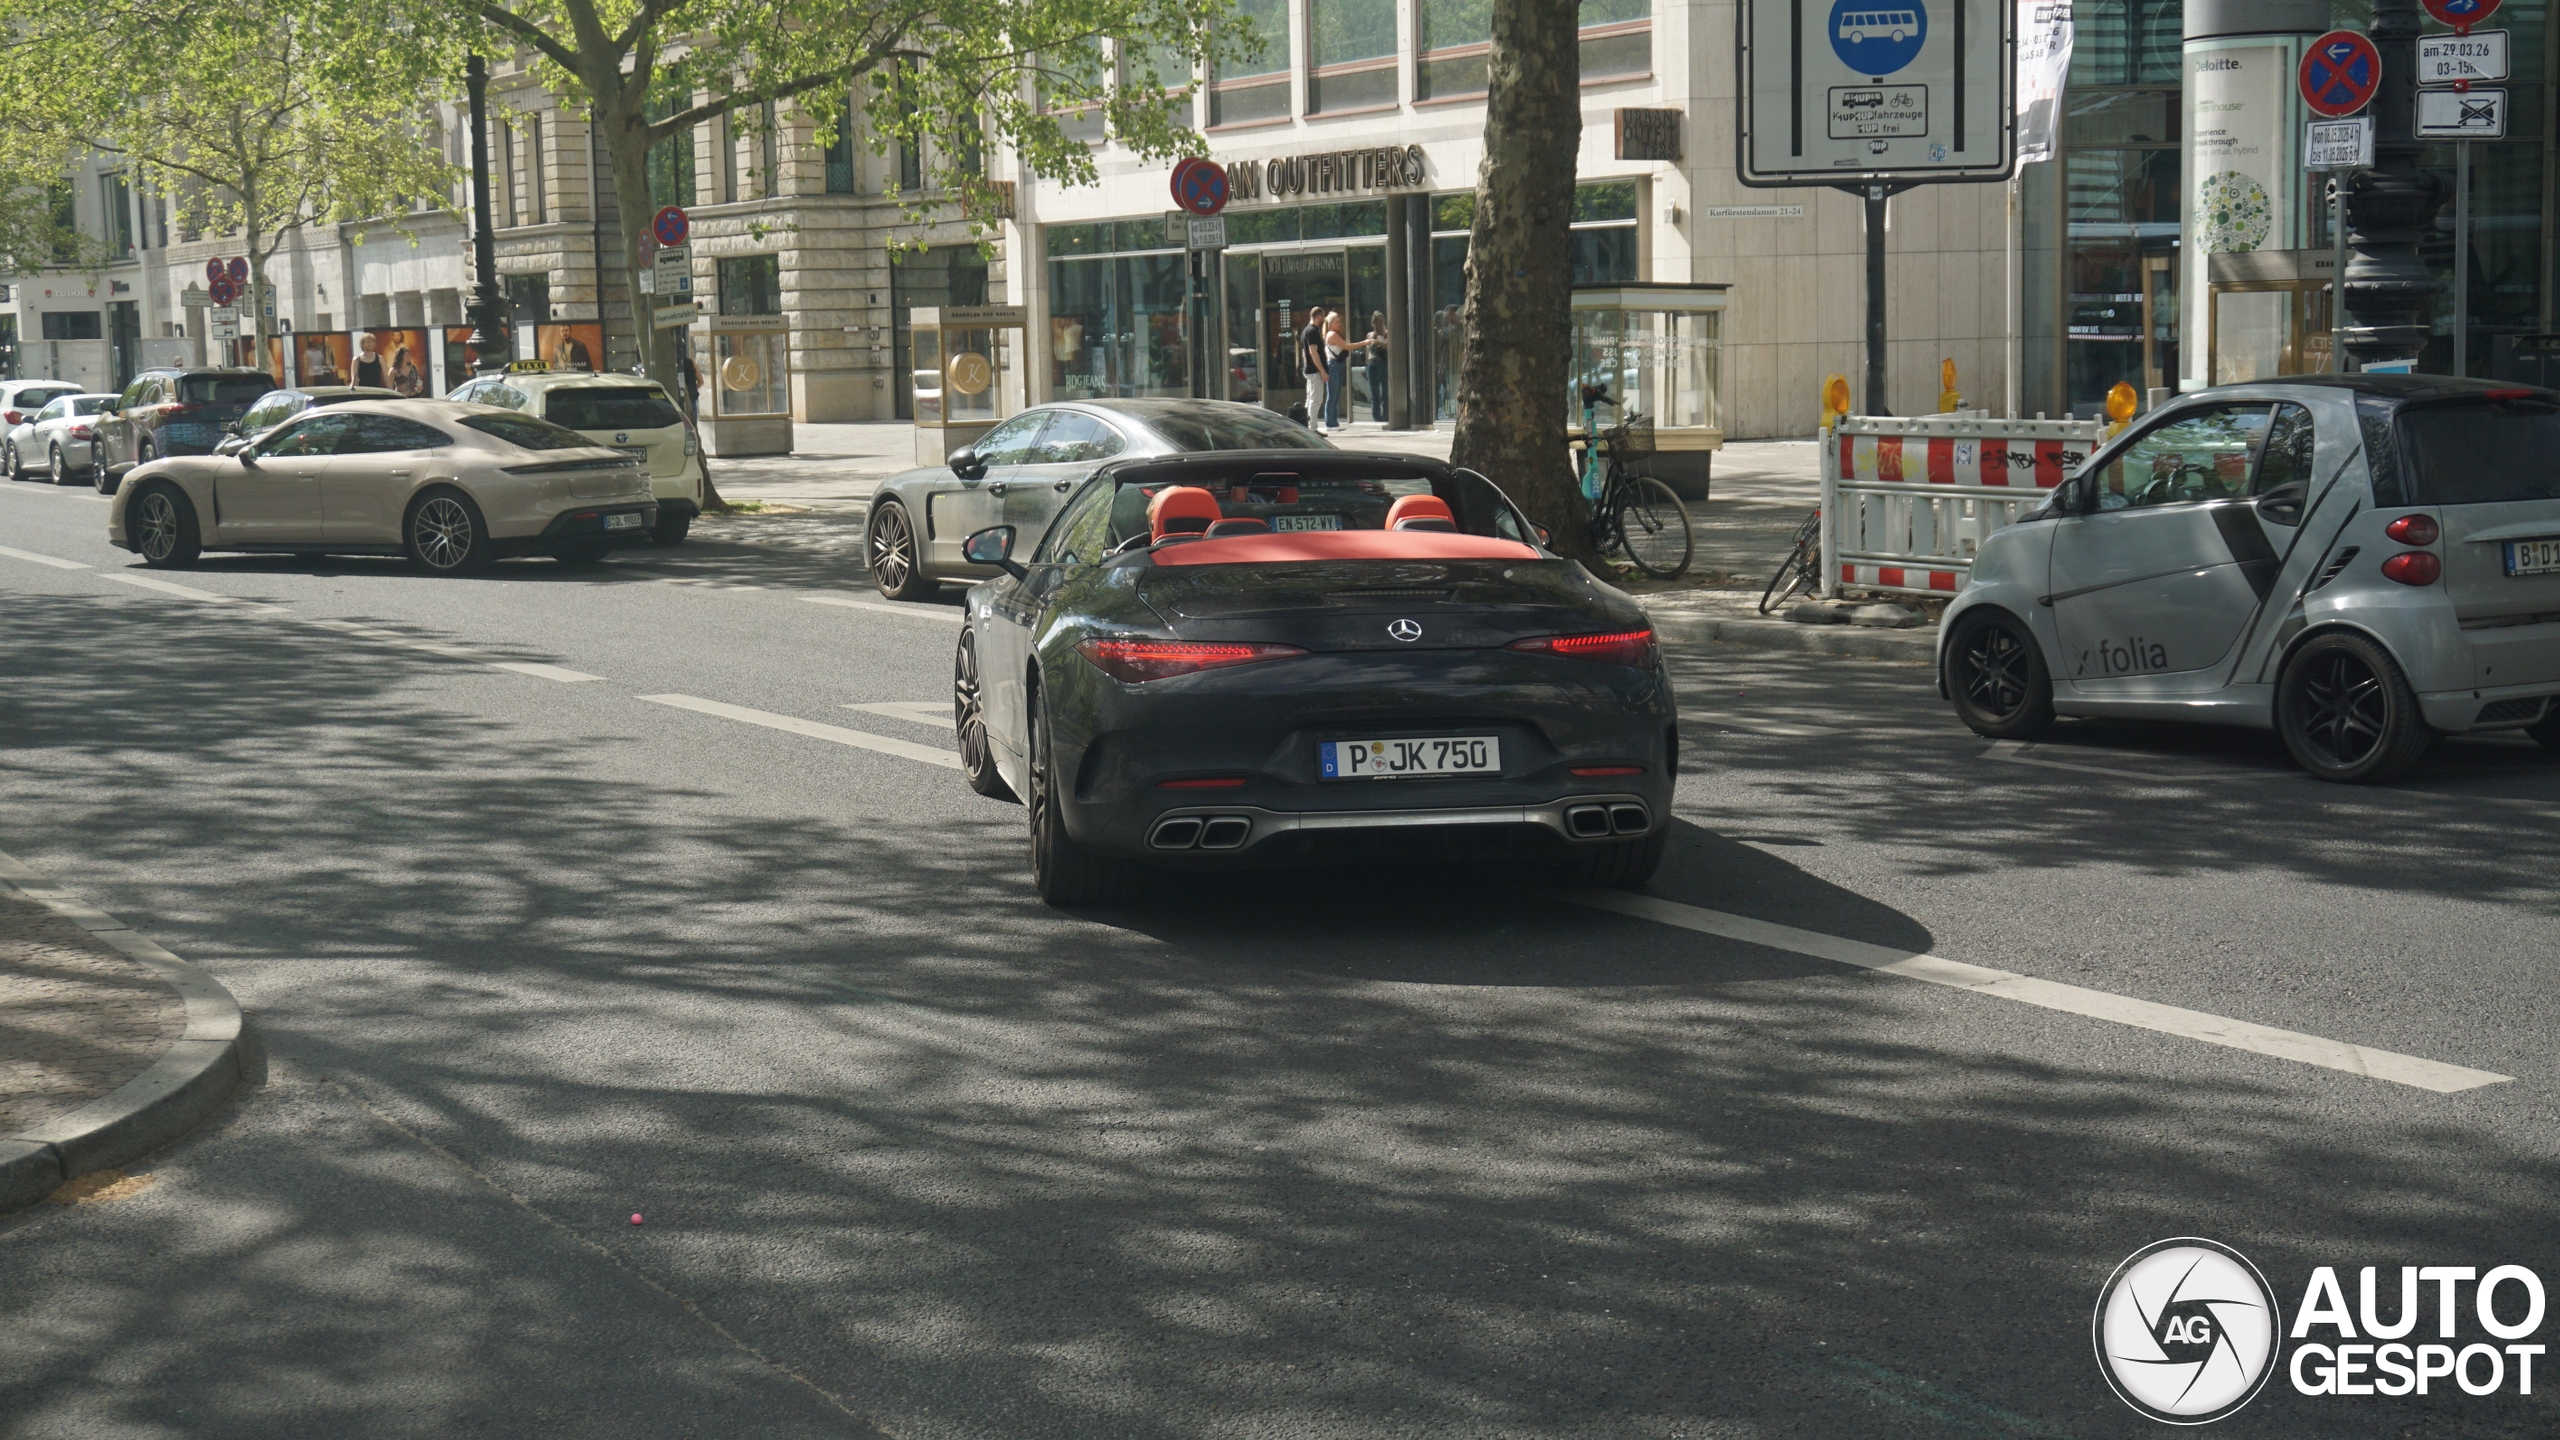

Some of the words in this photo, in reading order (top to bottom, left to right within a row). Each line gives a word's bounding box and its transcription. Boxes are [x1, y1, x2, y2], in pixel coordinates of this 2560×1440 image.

[2423, 47, 2439, 57] am
[2443, 43, 2490, 57] 29.03.26
[1624, 109, 1673, 125] URBAN
[1624, 125, 1675, 142] OUTFIT
[1883, 124, 1900, 133] frei
[2195, 137, 2238, 146] reakthrough
[1641, 142, 1676, 159] TERS
[2233, 146, 2258, 156] hybrid
[1267, 143, 1425, 196] OUTFITTERS
[1710, 207, 1777, 217] Kurfürstendamm
[1780, 207, 1800, 215] 21-24
[736, 364, 750, 382] K
[966, 363, 981, 383] K
[1083, 375, 1106, 393] JEANS
[1592, 473, 1600, 493] dott
[1280, 517, 1333, 531] EN-572-WY
[2521, 545, 2531, 567] B
[2099, 637, 2168, 673] folia
[1349, 745, 1367, 773] P
[1390, 742, 1427, 771] JK
[1433, 740, 1487, 769] 750
[1326, 763, 1333, 772] D
